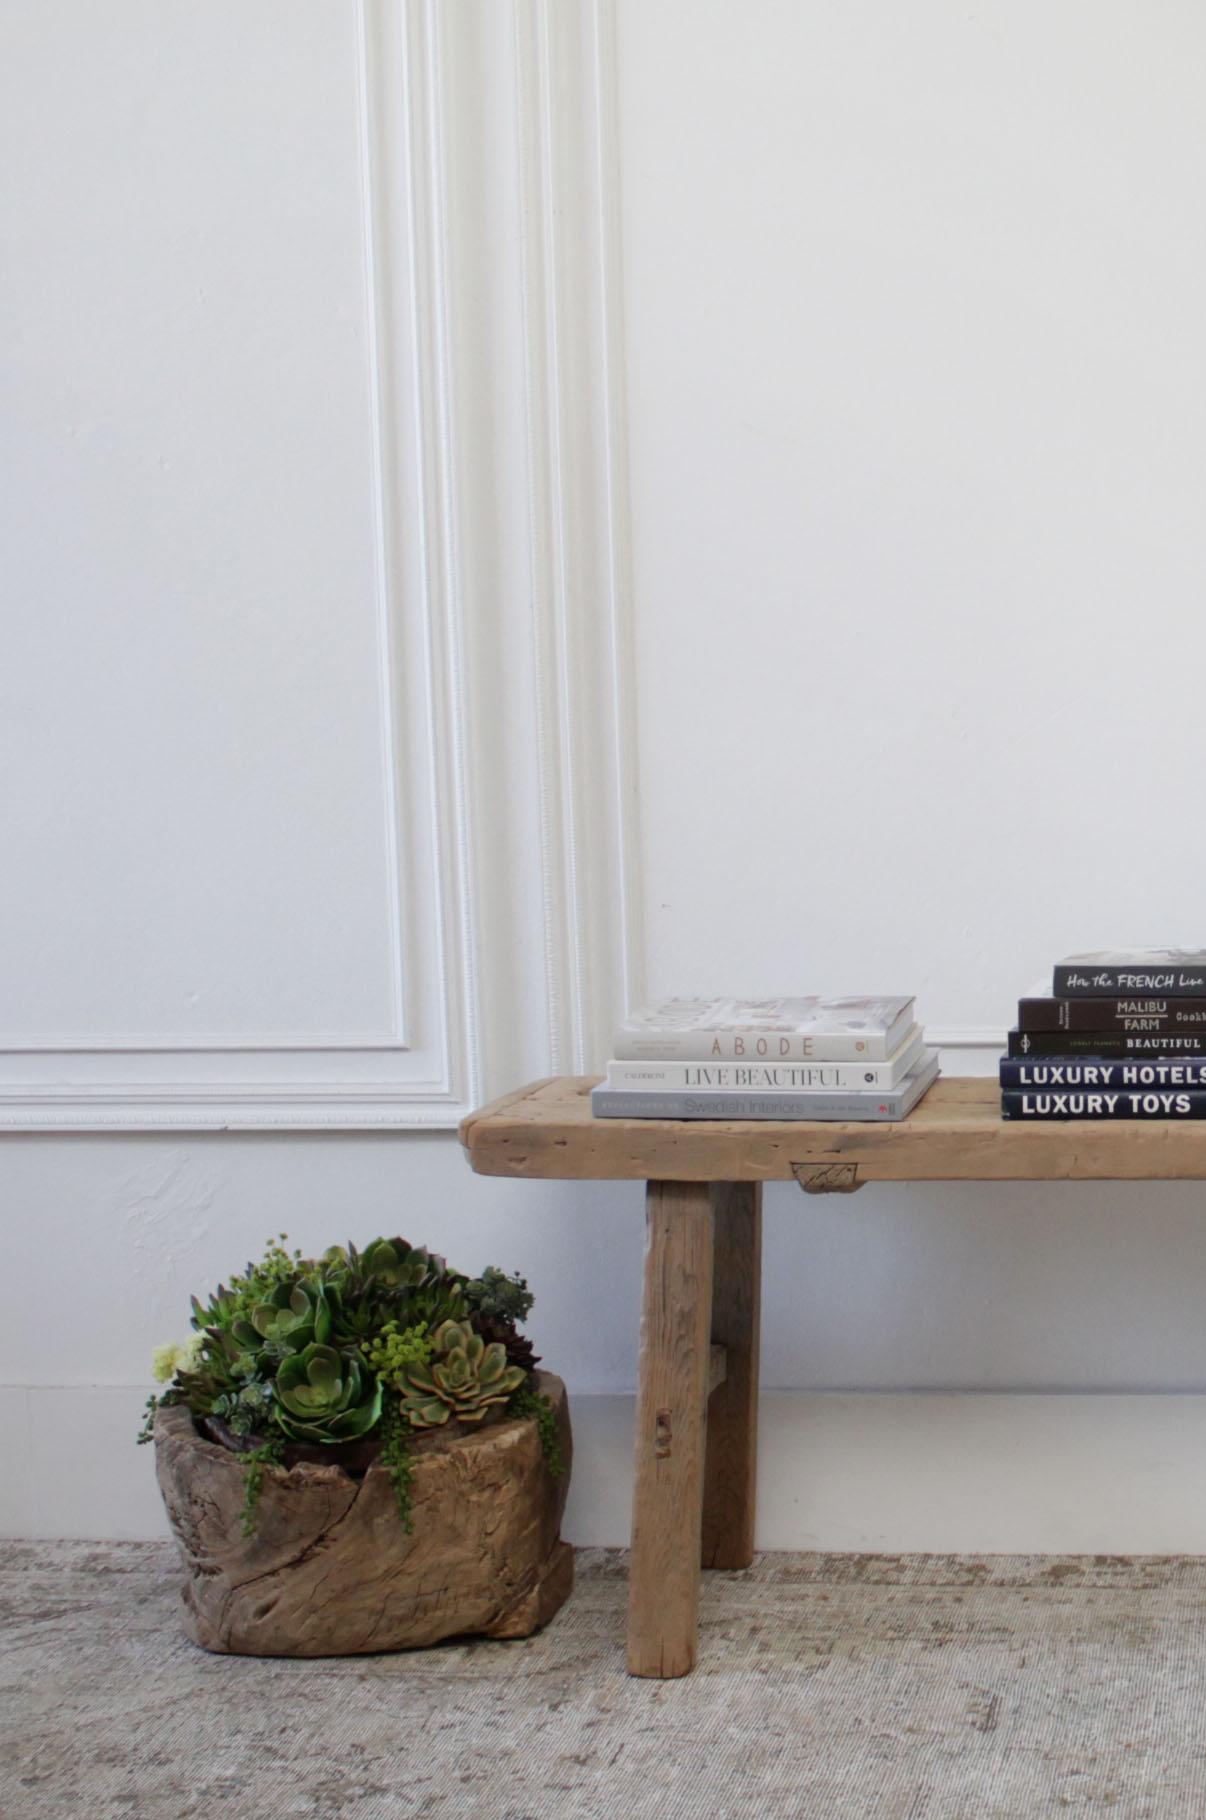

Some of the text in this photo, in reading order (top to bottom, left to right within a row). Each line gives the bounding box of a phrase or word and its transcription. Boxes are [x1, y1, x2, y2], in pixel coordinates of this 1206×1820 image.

[1066, 973, 1091, 988] How
[1093, 973, 1112, 986] the
[1116, 973, 1175, 989] FRENCH
[1178, 973, 1204, 987] Live
[1116, 1001, 1167, 1013] MALIBU
[1124, 1019, 1160, 1031] FARM
[711, 1037, 814, 1056] ABODE
[1126, 1038, 1201, 1049] BEAUTIFUL
[684, 1068, 846, 1087] LIVE BEAUTIFUL
[1019, 1066, 1114, 1084] LUXURY
[684, 1098, 745, 1113] Swedish
[749, 1099, 804, 1114] Interiors
[1022, 1095, 1191, 1113] LUXURY TOYS
